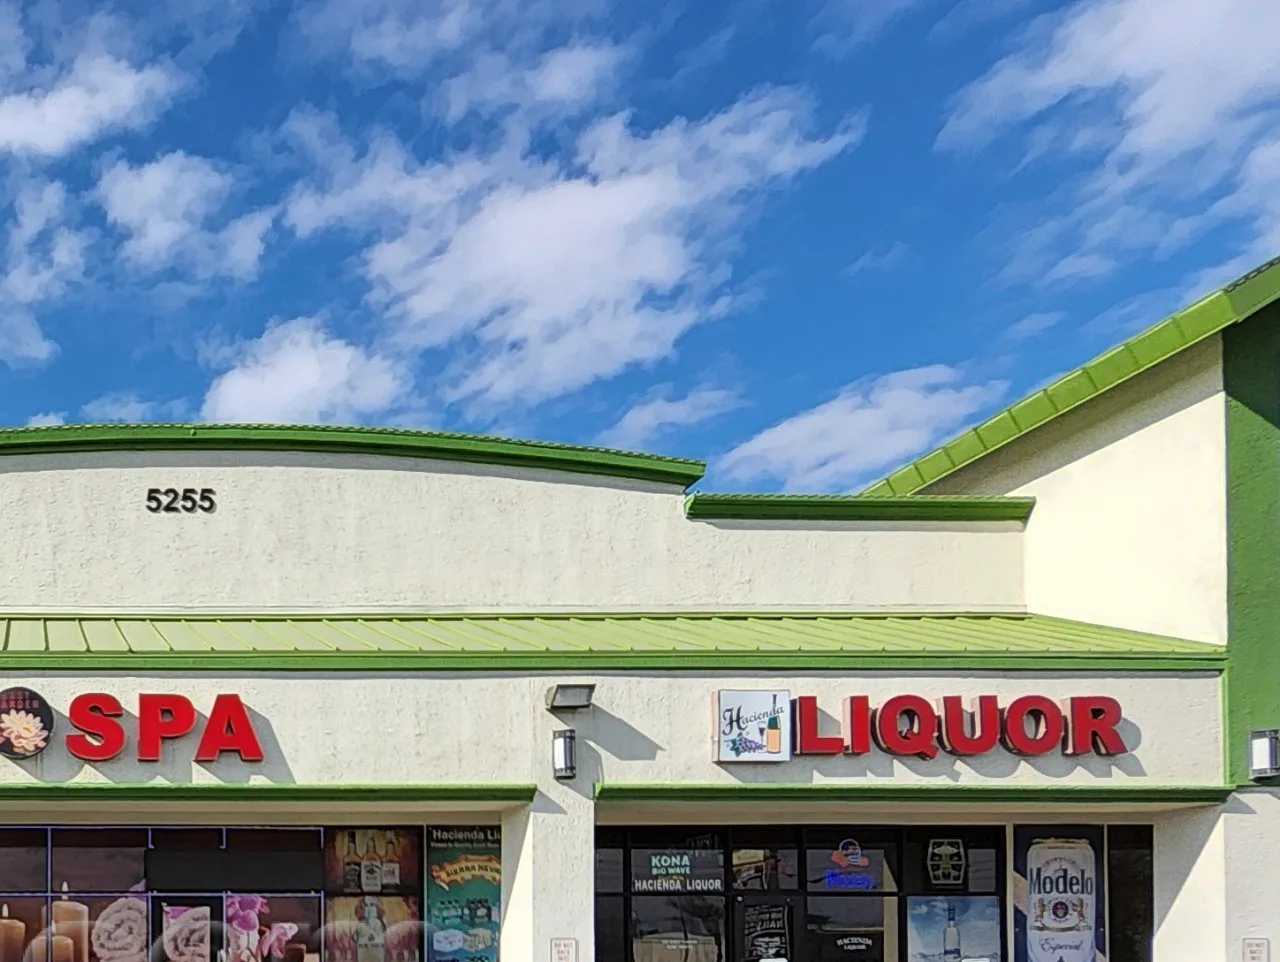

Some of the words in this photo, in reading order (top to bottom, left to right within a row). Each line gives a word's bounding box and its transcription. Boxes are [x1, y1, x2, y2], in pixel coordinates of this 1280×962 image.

[146, 487, 217, 514] 5255
[65, 692, 265, 762] SPA
[721, 704, 785, 736] Hacienda
[796, 694, 1129, 760] LIQUOR
[432, 829, 485, 840] Hacienda
[650, 854, 691, 867] KONA
[667, 867, 691, 875] WAVE
[634, 879, 682, 891] HACIENDA
[686, 879, 722, 891] LIQUOR
[1029, 867, 1094, 896] Modelo
